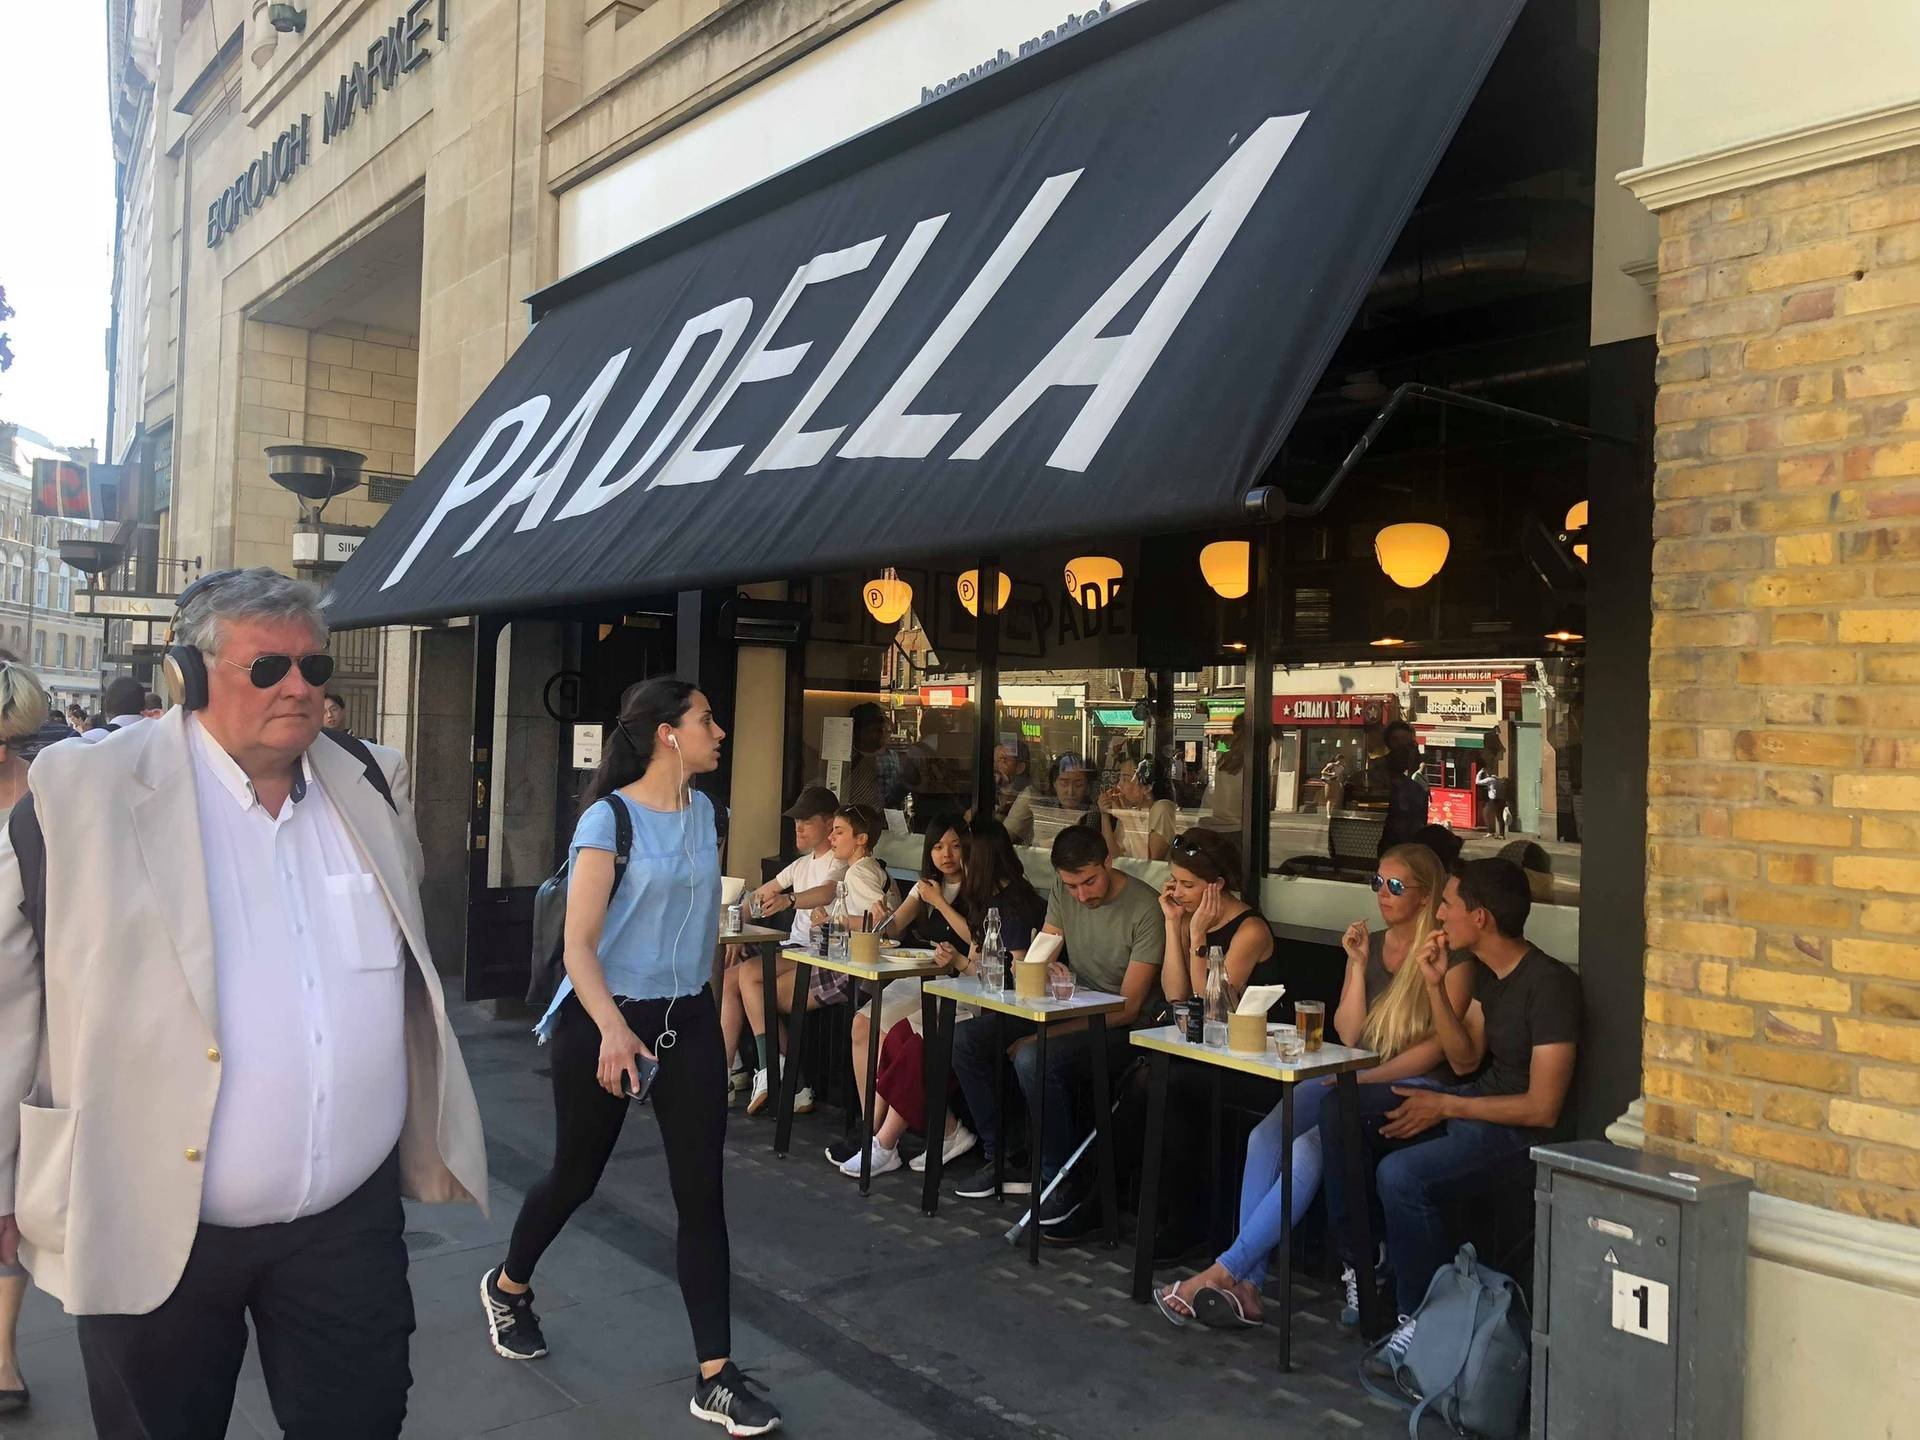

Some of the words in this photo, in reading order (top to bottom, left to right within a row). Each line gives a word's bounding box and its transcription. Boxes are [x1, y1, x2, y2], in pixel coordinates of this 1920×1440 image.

[1018, 0, 1112, 57] market
[206, 113, 311, 249] BOROUGH
[322, 0, 449, 145] MARKET
[378, 110, 1311, 592] PADELLA
[100, 600, 152, 613] SILKA
[1632, 1285, 1649, 1329] 1
